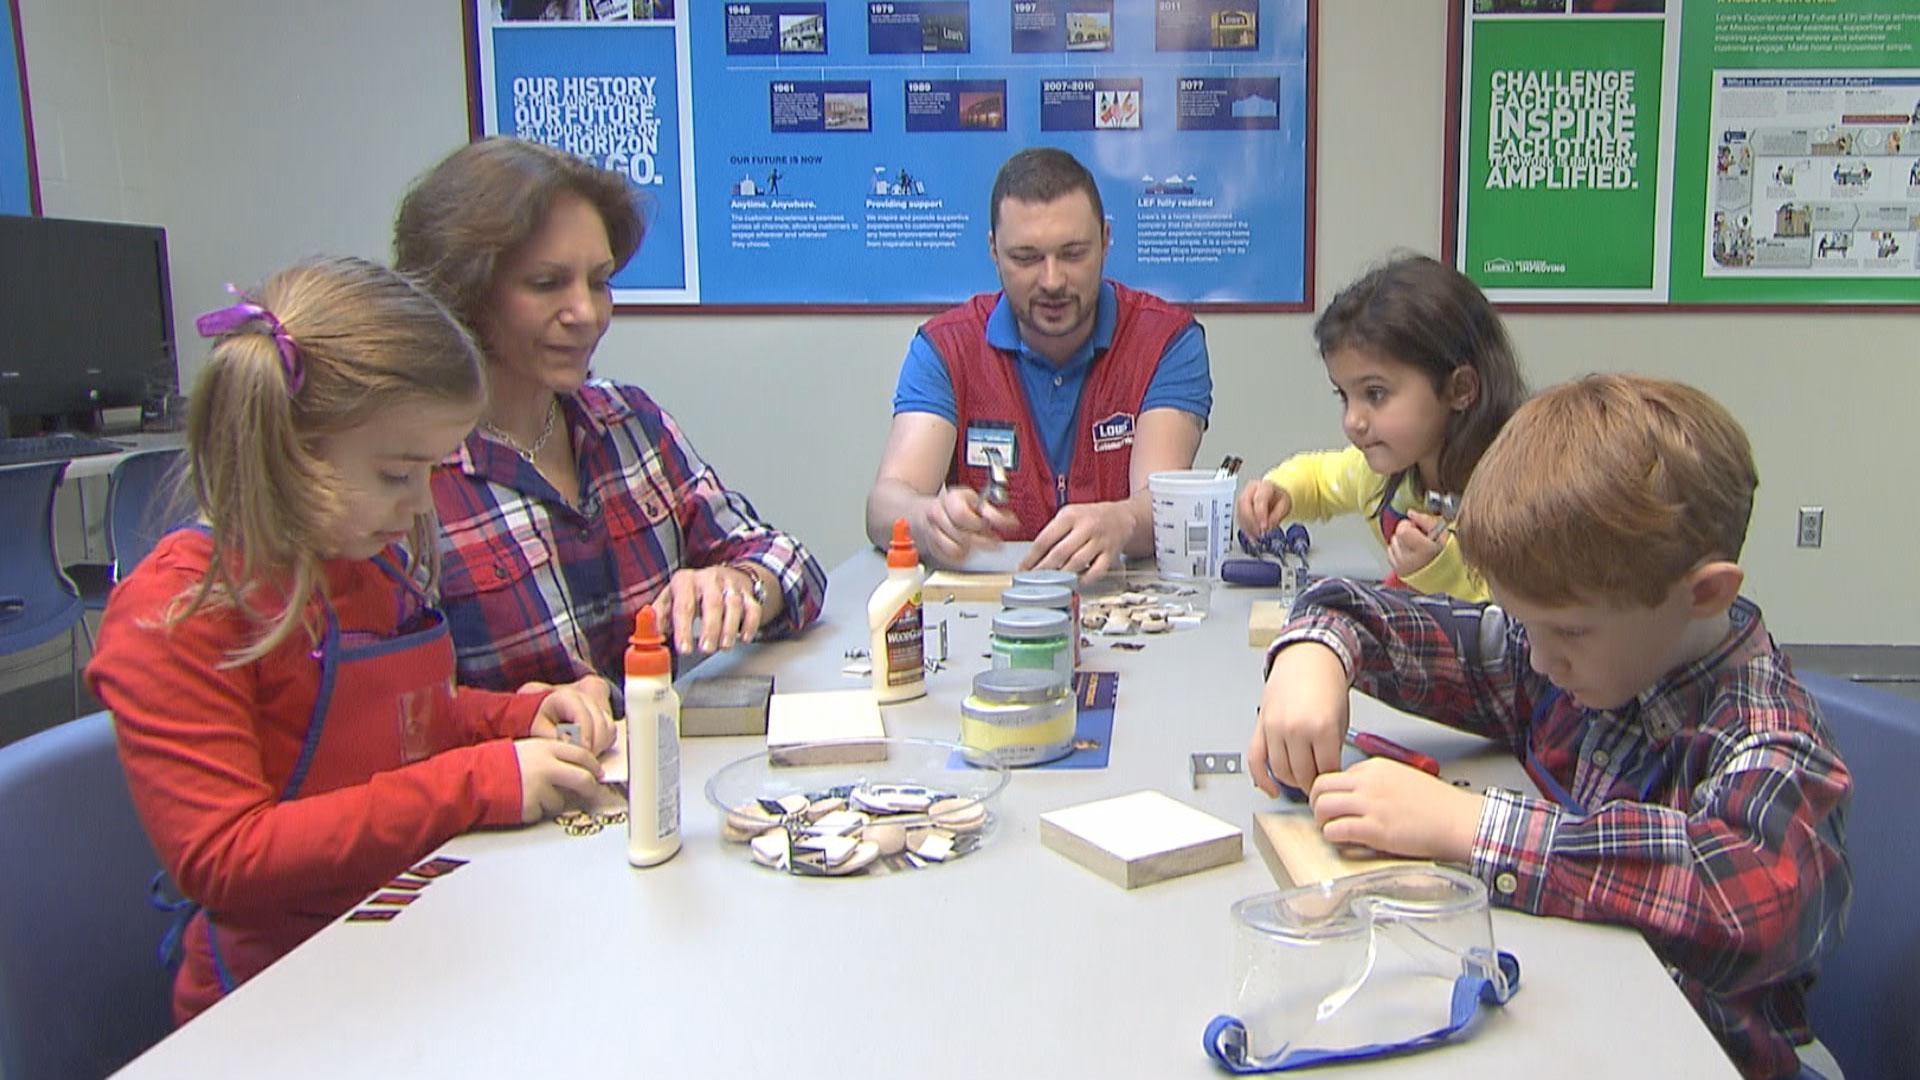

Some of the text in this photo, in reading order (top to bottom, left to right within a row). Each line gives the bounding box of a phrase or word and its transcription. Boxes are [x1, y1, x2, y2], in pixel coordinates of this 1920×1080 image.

[514, 77, 656, 97] OUR HISTORY
[1492, 70, 1635, 92] CHALLENGE
[1492, 91, 1550, 109] EACH
[515, 105, 661, 126] OUR FUTURE.
[1490, 109, 1635, 140] INSPIRE
[565, 135, 657, 154] HORIZON
[1489, 139, 1550, 158] EACH
[730, 156, 822, 165] OUR FUTURE IS NOW
[1485, 166, 1638, 189] AMPLIFIED.
[866, 199, 943, 209] Providing support
[1138, 198, 1213, 208] LEF fully realized
